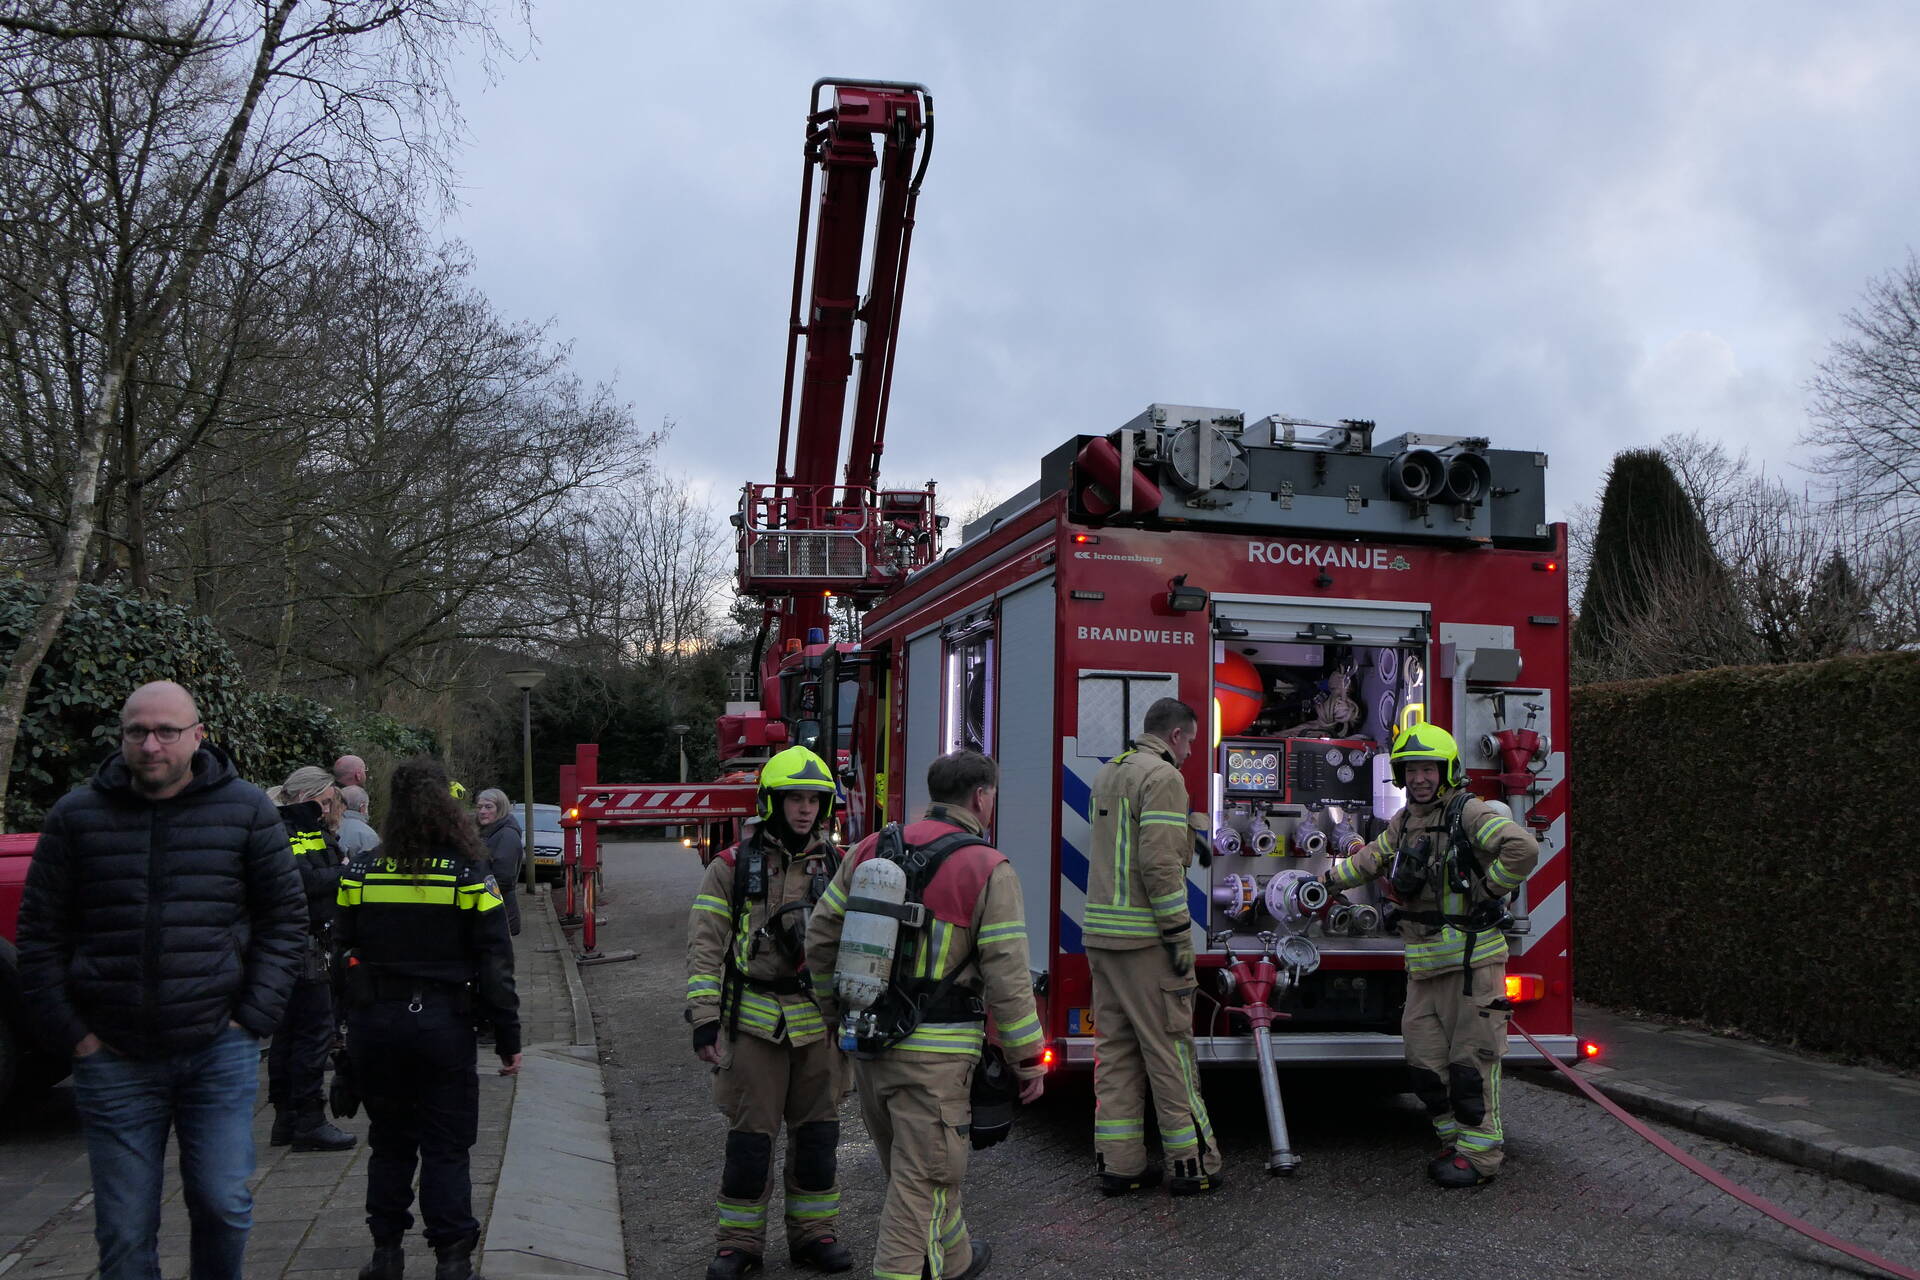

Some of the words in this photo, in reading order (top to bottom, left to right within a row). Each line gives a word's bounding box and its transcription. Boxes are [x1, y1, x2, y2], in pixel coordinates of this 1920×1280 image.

[1093, 552, 1163, 564] kronenburg
[1248, 541, 1388, 570] ROCKANJE
[1077, 626, 1195, 645] BRANDWEER
